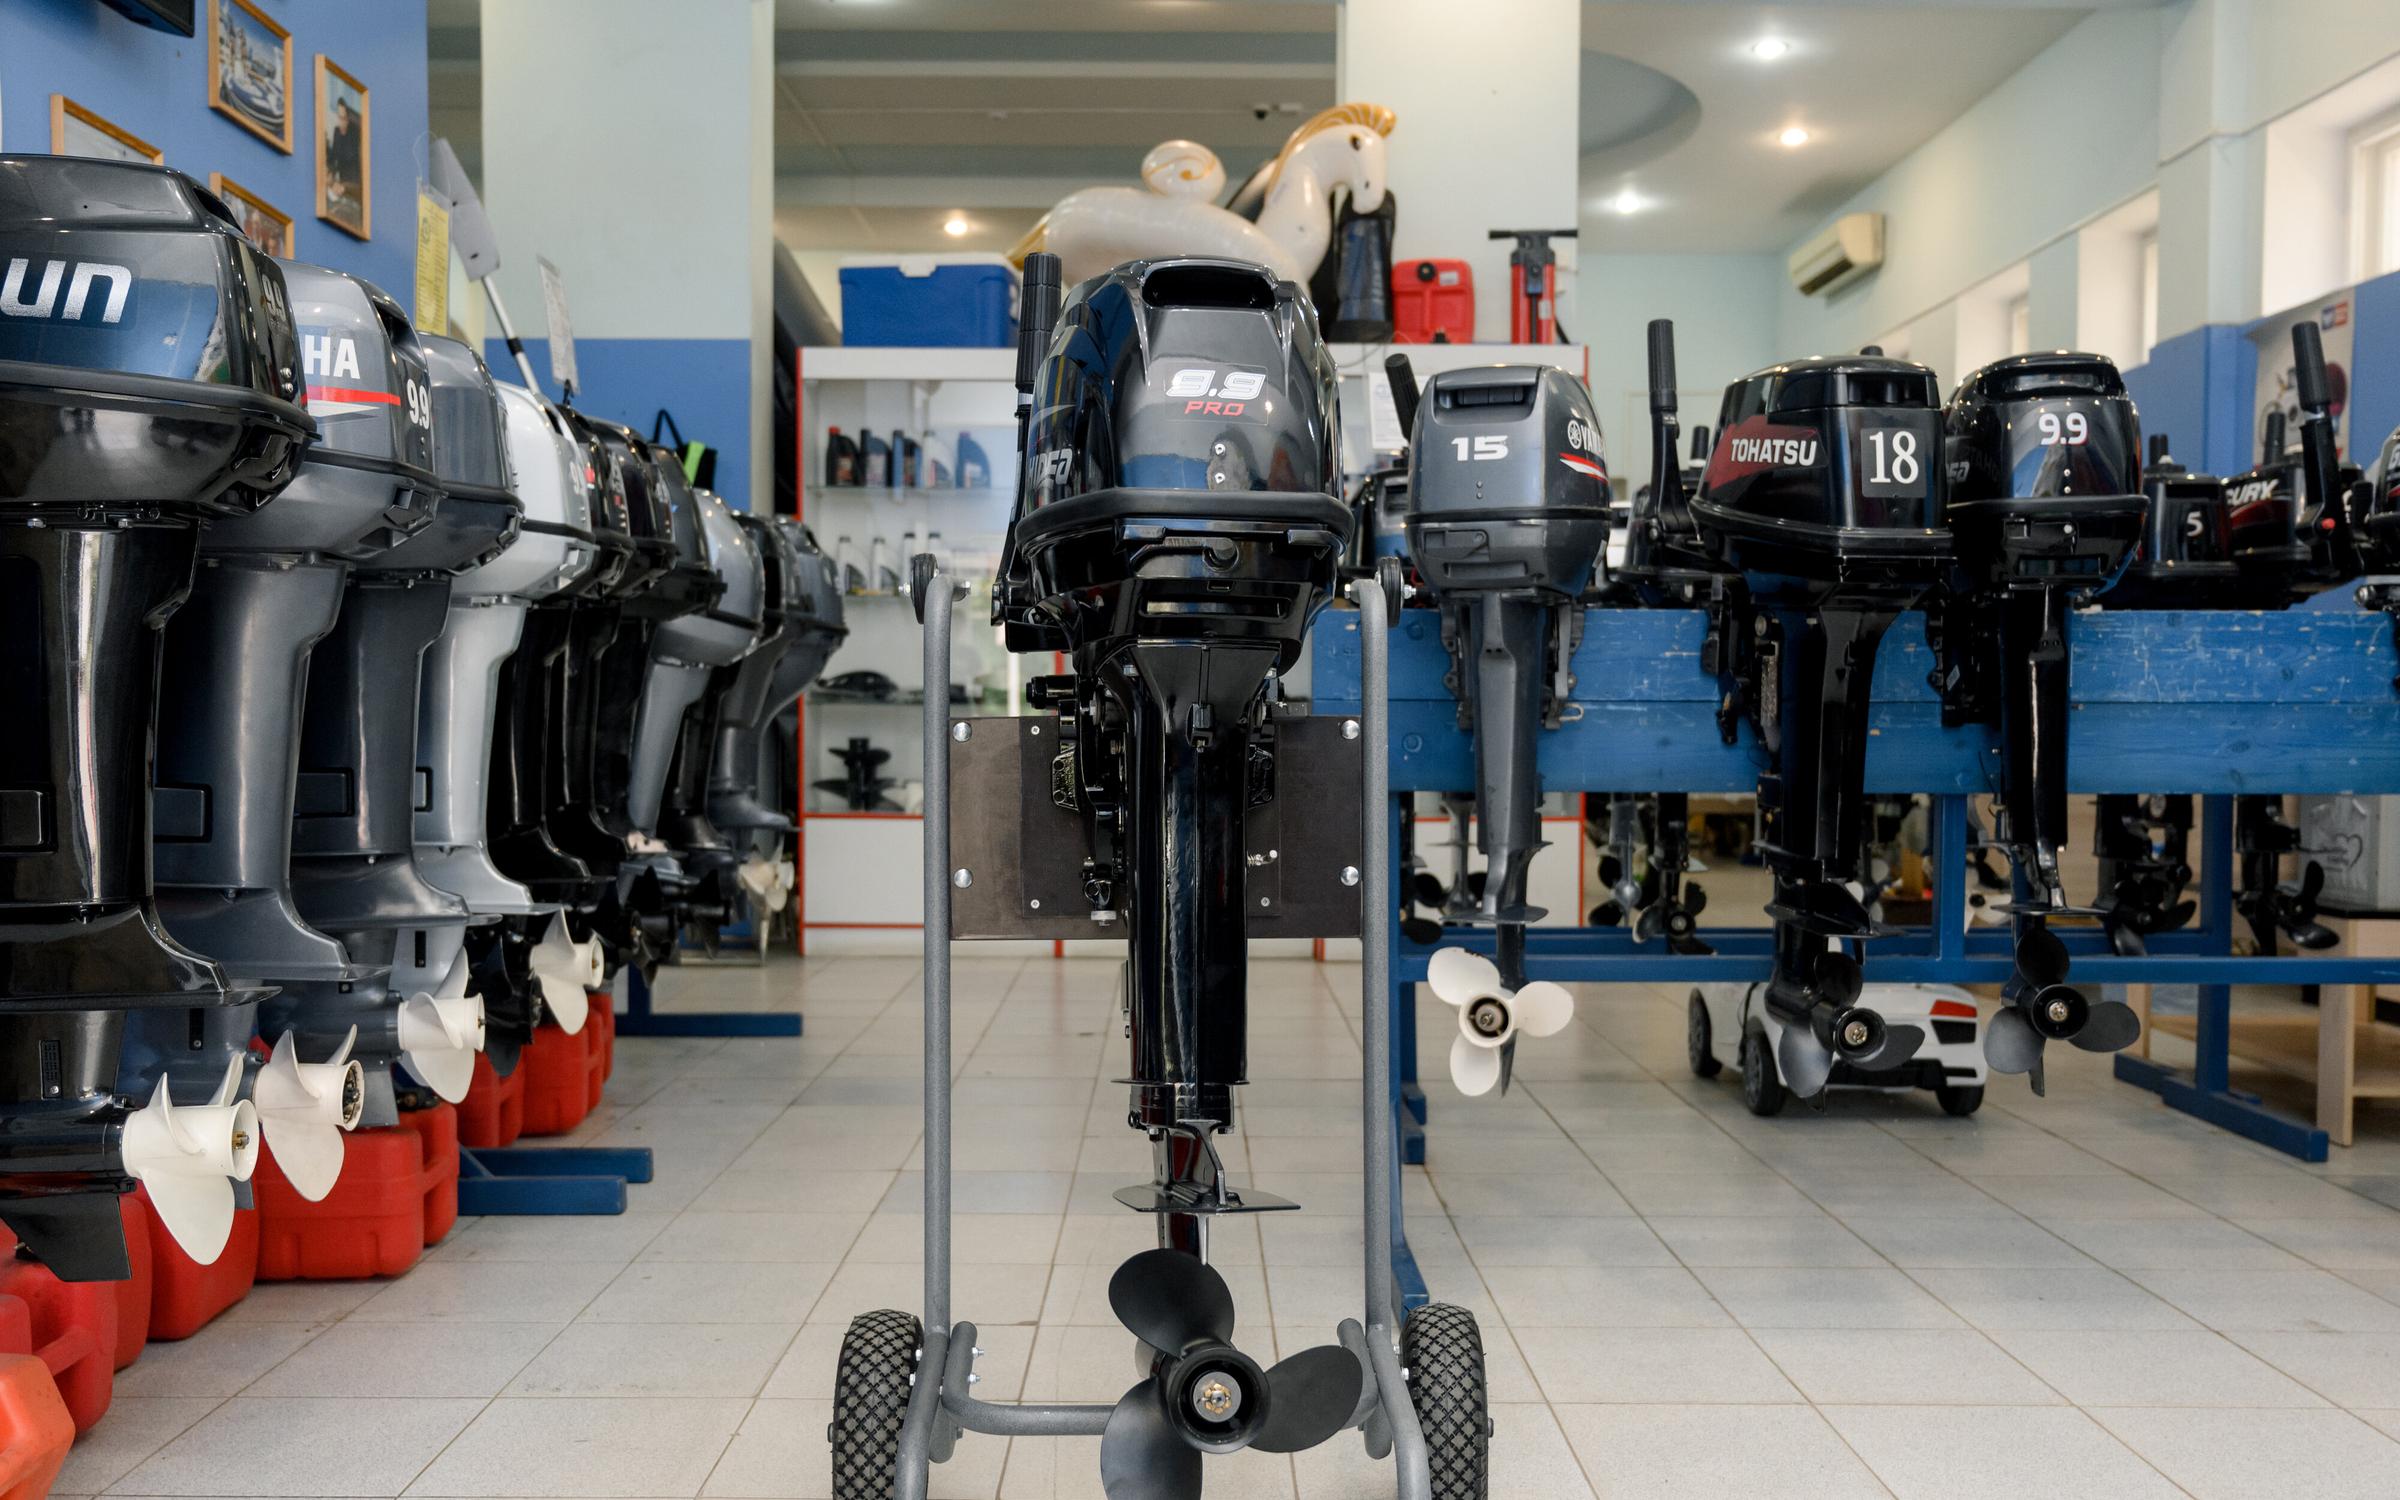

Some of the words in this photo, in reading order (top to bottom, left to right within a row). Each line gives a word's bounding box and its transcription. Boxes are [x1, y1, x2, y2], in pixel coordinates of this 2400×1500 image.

[304, 334, 360, 379] HA
[1166, 370, 1266, 400] 9.9
[407, 378, 430, 430] 9.9
[1184, 401, 1246, 417] PRO
[2038, 412, 2087, 446] 9.9
[1451, 435, 1509, 462] 15
[1731, 438, 1817, 466] TOHATSU
[1869, 431, 1919, 484] 18
[2187, 511, 2203, 537] 5
